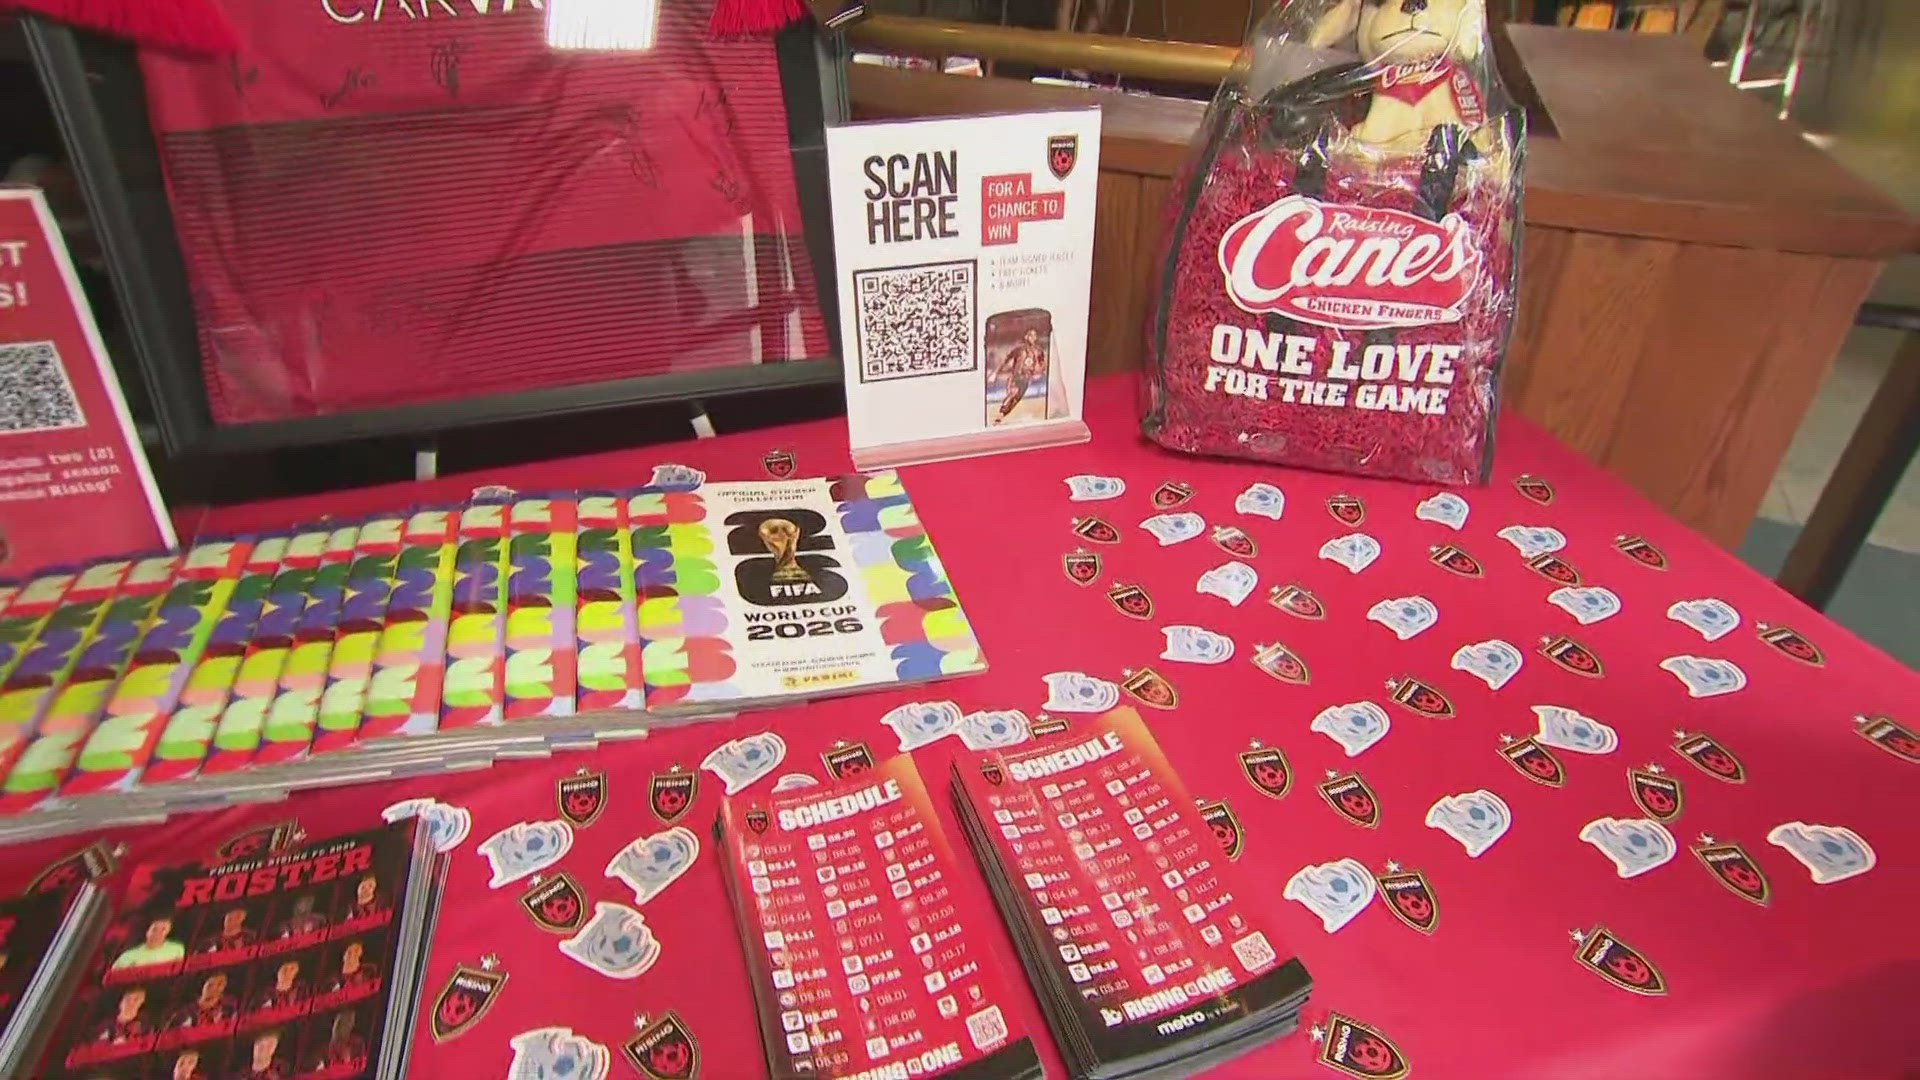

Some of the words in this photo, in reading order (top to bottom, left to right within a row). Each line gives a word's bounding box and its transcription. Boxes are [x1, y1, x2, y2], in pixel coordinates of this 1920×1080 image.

[863, 150, 957, 201] SCAN
[988, 182, 1012, 198] FOR
[1016, 183, 1025, 195] A
[866, 195, 959, 245] HERE
[988, 201, 1038, 219] CHANCE
[1043, 200, 1058, 215] TO
[988, 225, 1012, 241] WIN
[1328, 211, 1415, 240] Raising
[1231, 197, 1476, 304] Cane's
[1307, 298, 1371, 316] CHICKEN
[1377, 304, 1443, 321] FINGERS
[1210, 324, 1316, 374] ONE
[1327, 339, 1465, 385] LOVE
[1205, 365, 1271, 400] FOR
[1279, 378, 1346, 407] THE
[1355, 383, 1449, 415] GAME
[769, 582, 822, 598] FIFA
[744, 607, 815, 623] WORLD
[819, 605, 857, 617] CUP
[746, 618, 864, 642] 2026
[1008, 730, 1124, 782] SCHEDULE
[563, 780, 599, 792] RISING
[656, 779, 690, 788] RISING
[778, 778, 903, 831] SCHEDULE
[269, 852, 307, 866] RISING
[176, 844, 373, 908] ROSTER
[854, 912, 882, 929] 07.04
[785, 930, 814, 943] 04.11
[859, 932, 884, 948] 07.11
[454, 977, 491, 992] RISING
[1122, 986, 1189, 1021] RISING
[1197, 966, 1237, 994] ONE
[1157, 1011, 1206, 1036] metro
[635, 1024, 673, 1055] RISING
[921, 1042, 963, 1071] ONE
